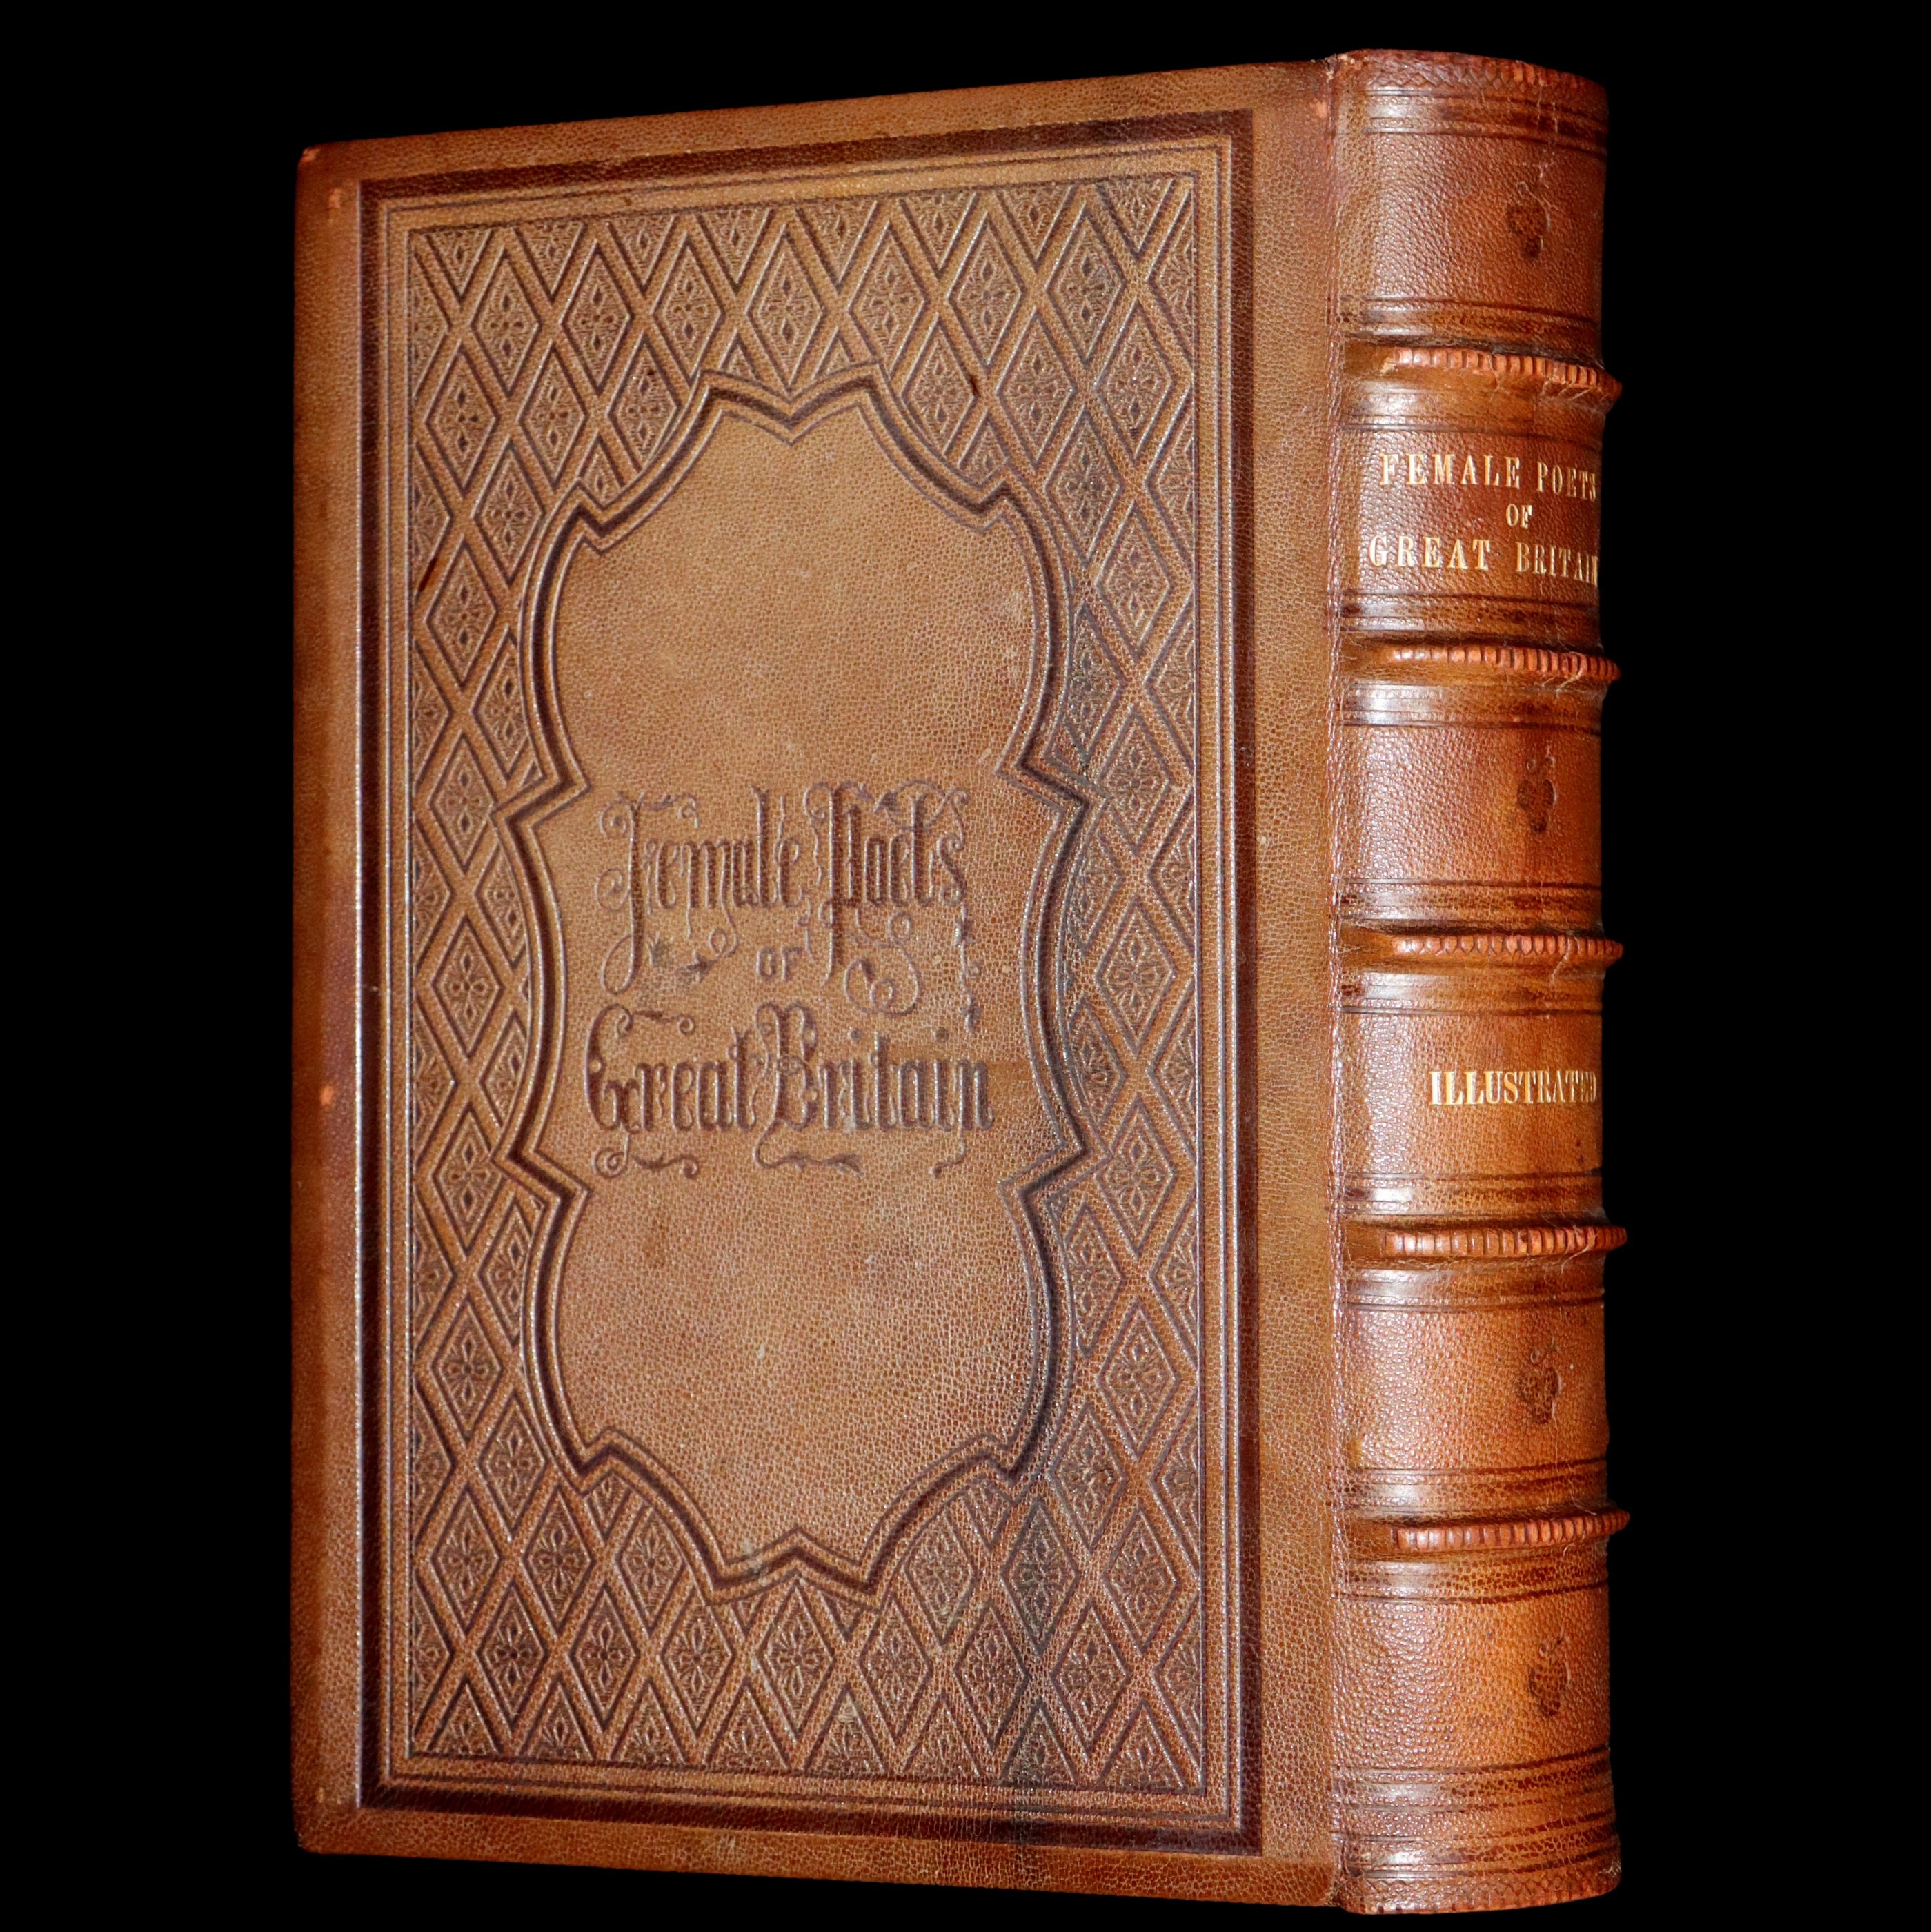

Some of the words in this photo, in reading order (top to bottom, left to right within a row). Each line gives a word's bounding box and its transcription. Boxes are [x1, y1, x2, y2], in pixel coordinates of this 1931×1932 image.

[1379, 453, 1521, 489] FEMALE
[1536, 461, 1596, 502] POETS
[1505, 503, 1533, 529] OF
[1369, 535, 1491, 571] GREAT
[1515, 541, 1598, 587] BRITAIN
[596, 785, 802, 969] Female
[804, 782, 967, 966] Poets
[584, 1003, 757, 1142] Great
[755, 1003, 993, 1142] Britain
[1428, 1070, 1597, 1105] ILLUSTRATED
